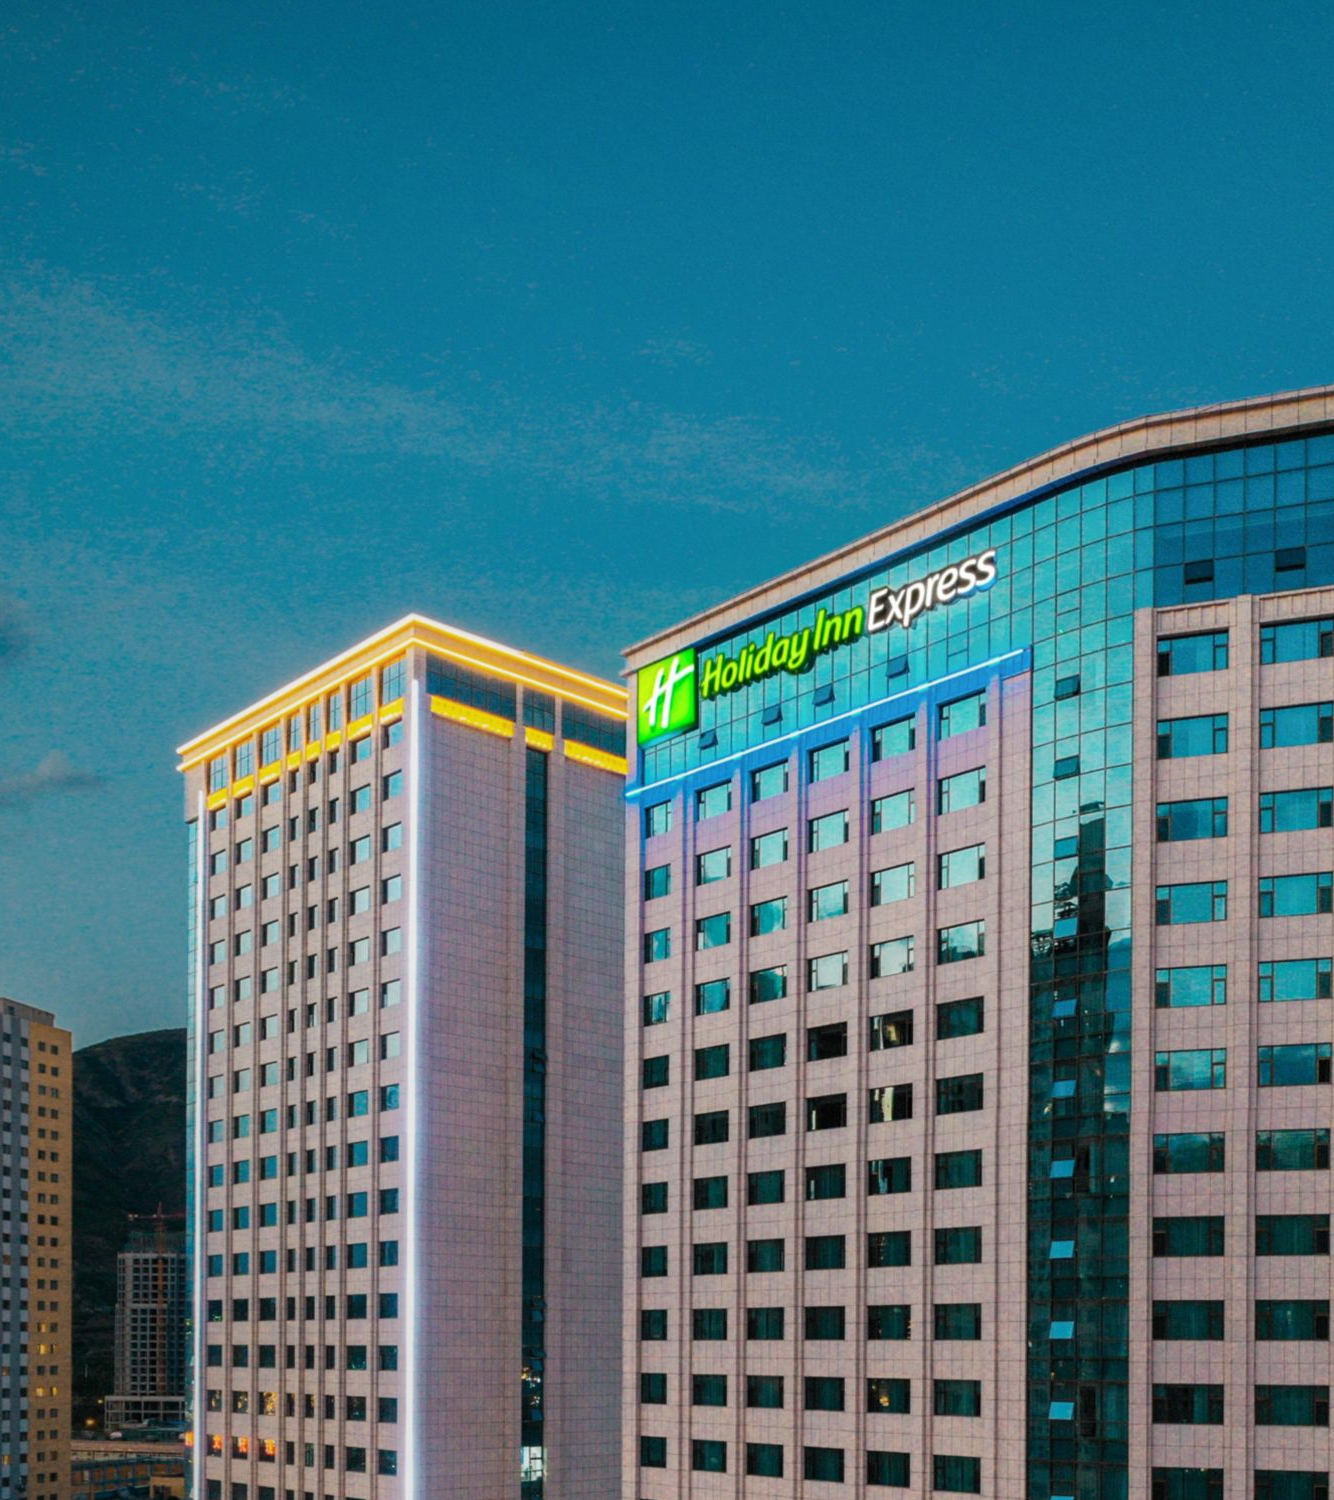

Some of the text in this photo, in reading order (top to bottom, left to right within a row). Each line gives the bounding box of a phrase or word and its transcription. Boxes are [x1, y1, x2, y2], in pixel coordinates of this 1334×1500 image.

[701, 549, 997, 698] Holiday Inn Express
